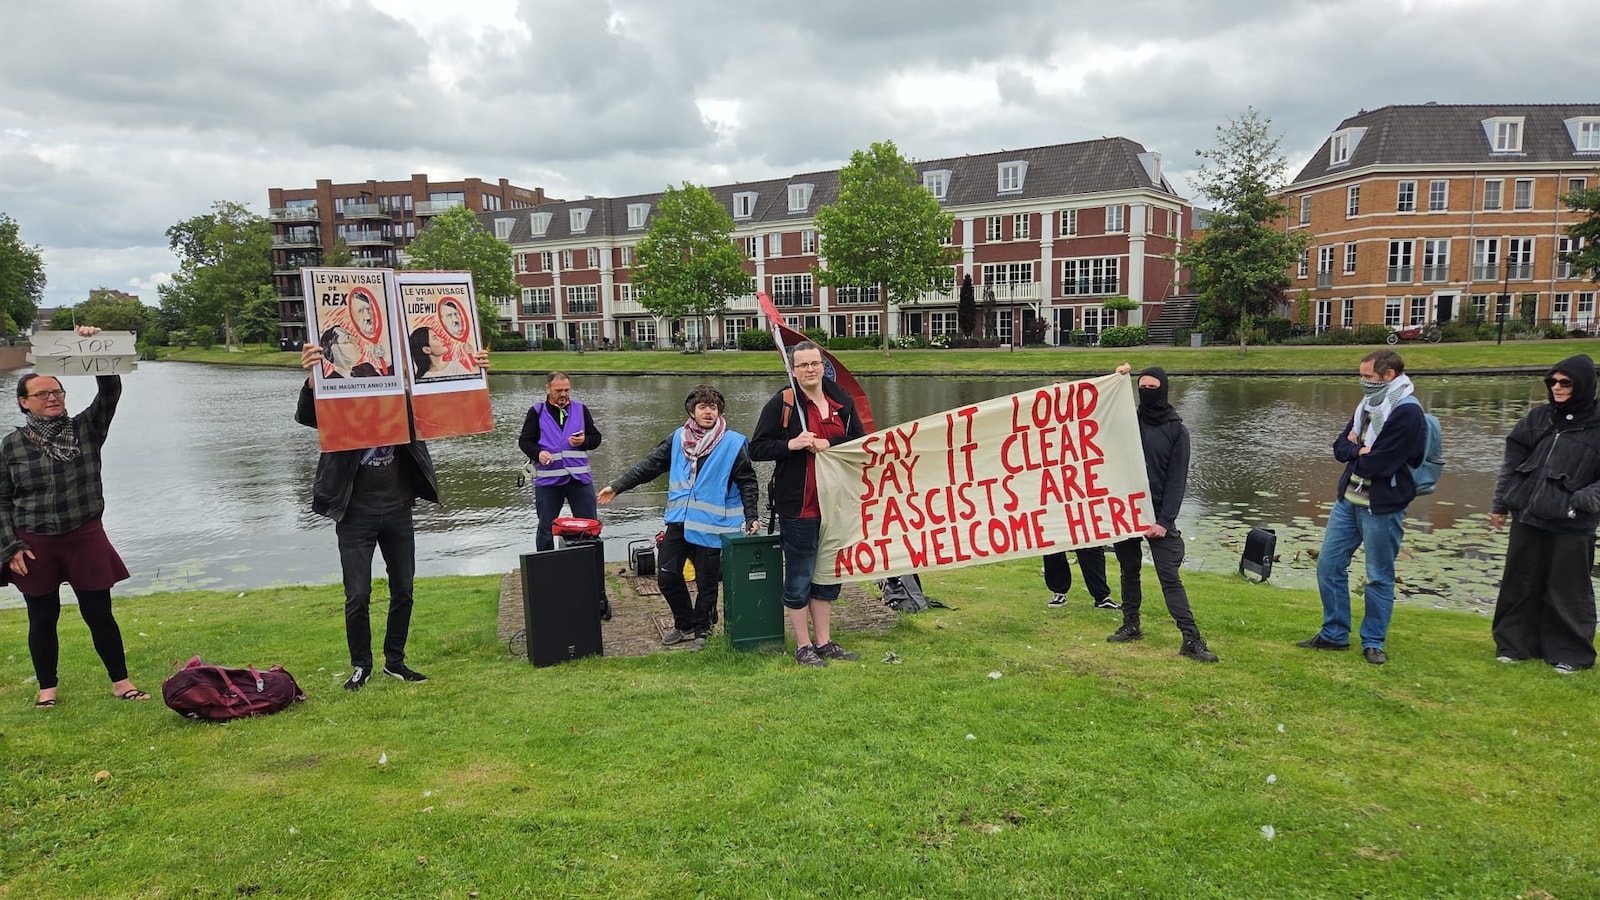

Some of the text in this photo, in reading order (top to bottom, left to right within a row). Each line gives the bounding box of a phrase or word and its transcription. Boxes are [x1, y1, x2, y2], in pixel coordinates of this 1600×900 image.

[316, 275, 381, 284] LE VRAI VISAGE
[322, 293, 348, 306] REX
[408, 303, 436, 313] LIDEWIJ
[50, 337, 114, 355] STOP
[861, 382, 1098, 467] SAY IT LOUD
[860, 420, 1104, 502] SAY IT CLEAR
[861, 458, 1109, 540] FASCISTS ARE
[834, 492, 1151, 578] NOT WELCOME HERE
